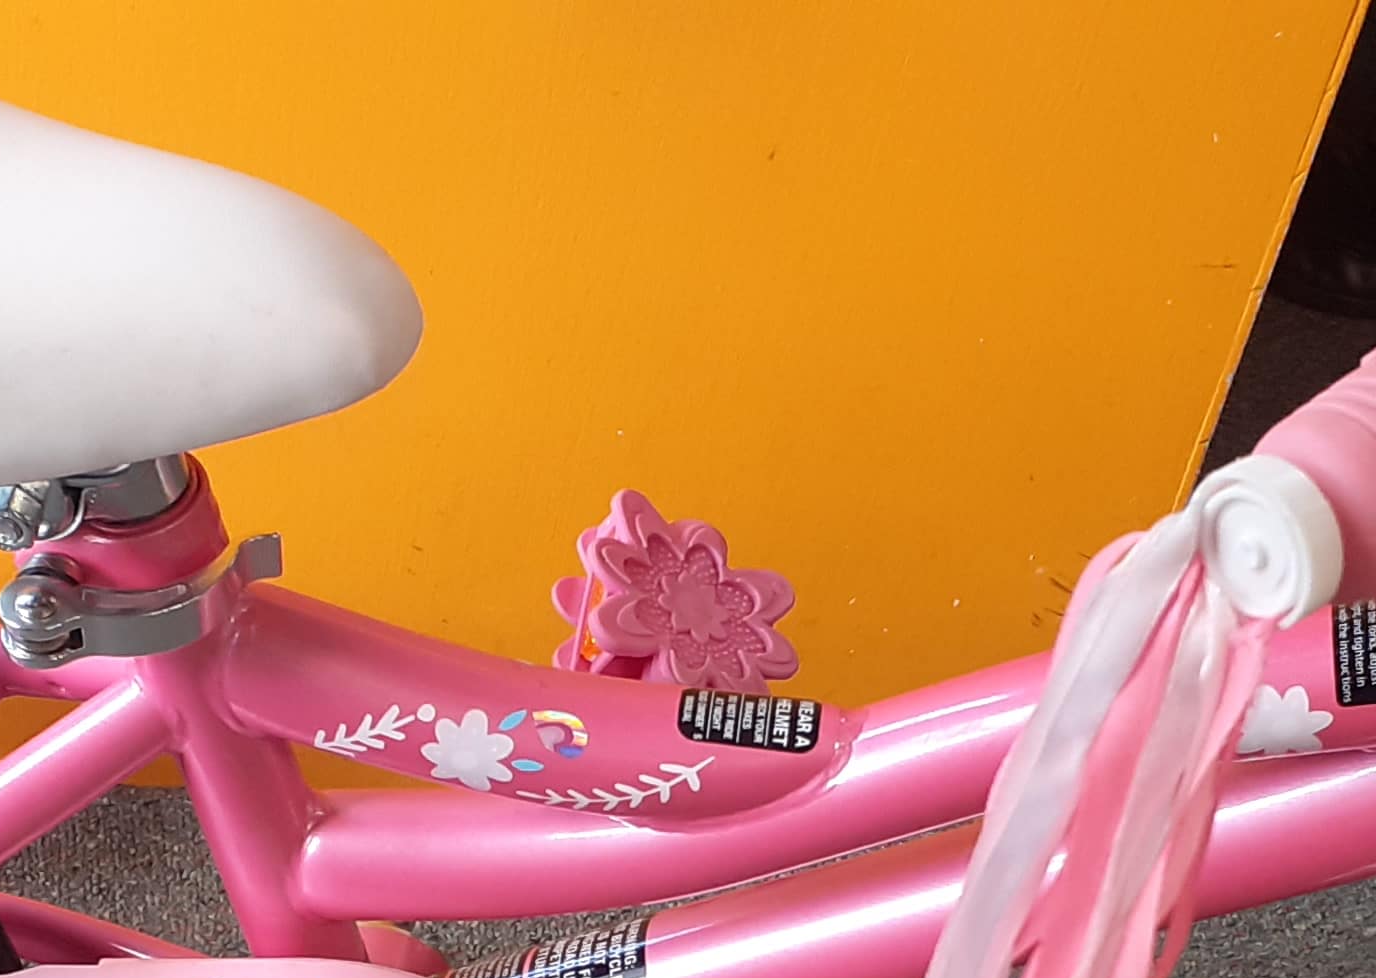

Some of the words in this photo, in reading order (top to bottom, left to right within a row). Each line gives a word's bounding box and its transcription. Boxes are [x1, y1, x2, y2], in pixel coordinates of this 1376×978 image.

[1352, 637, 1366, 674] tighten
[1357, 676, 1368, 688] in
[795, 735, 812, 748] A
